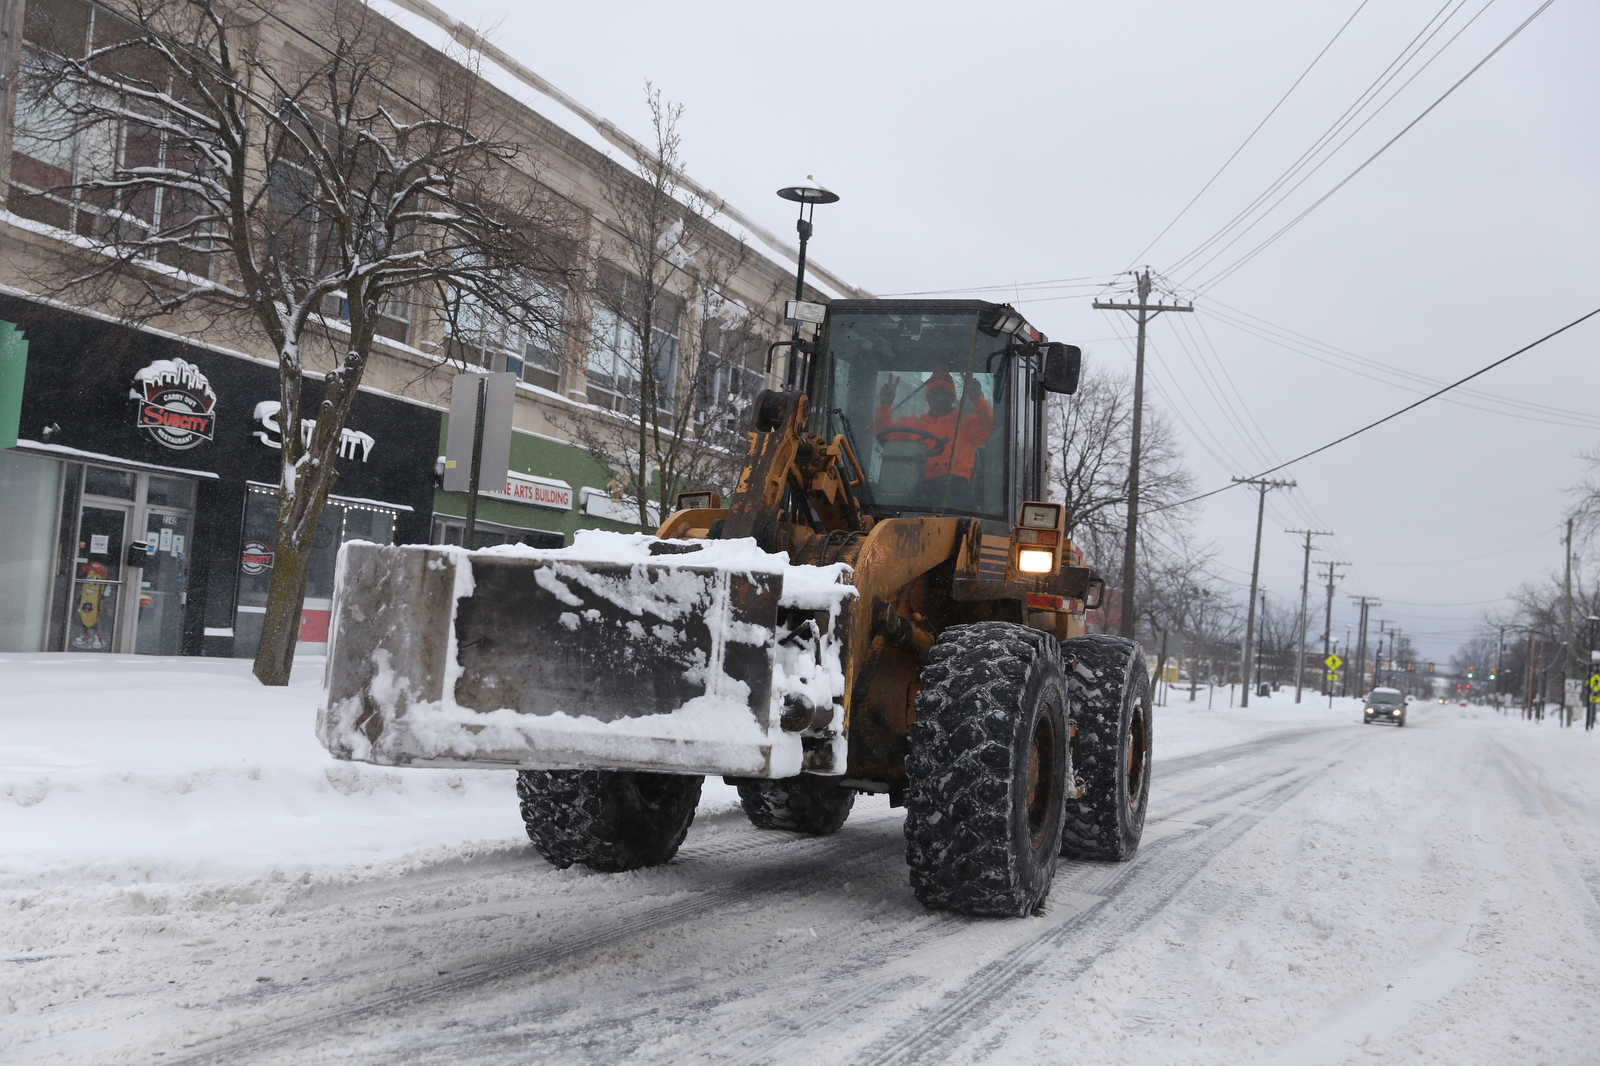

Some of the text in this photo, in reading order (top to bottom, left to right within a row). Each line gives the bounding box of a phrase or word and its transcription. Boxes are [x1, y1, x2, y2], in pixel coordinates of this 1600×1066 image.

[163, 393, 197, 408] CARRY OUT
[143, 405, 209, 432] SUBCITY
[157, 428, 193, 444] RESTAURANT
[513, 484, 533, 500] ARTS
[535, 487, 569, 506] BUILDING
[894, 522, 921, 560] 721B
